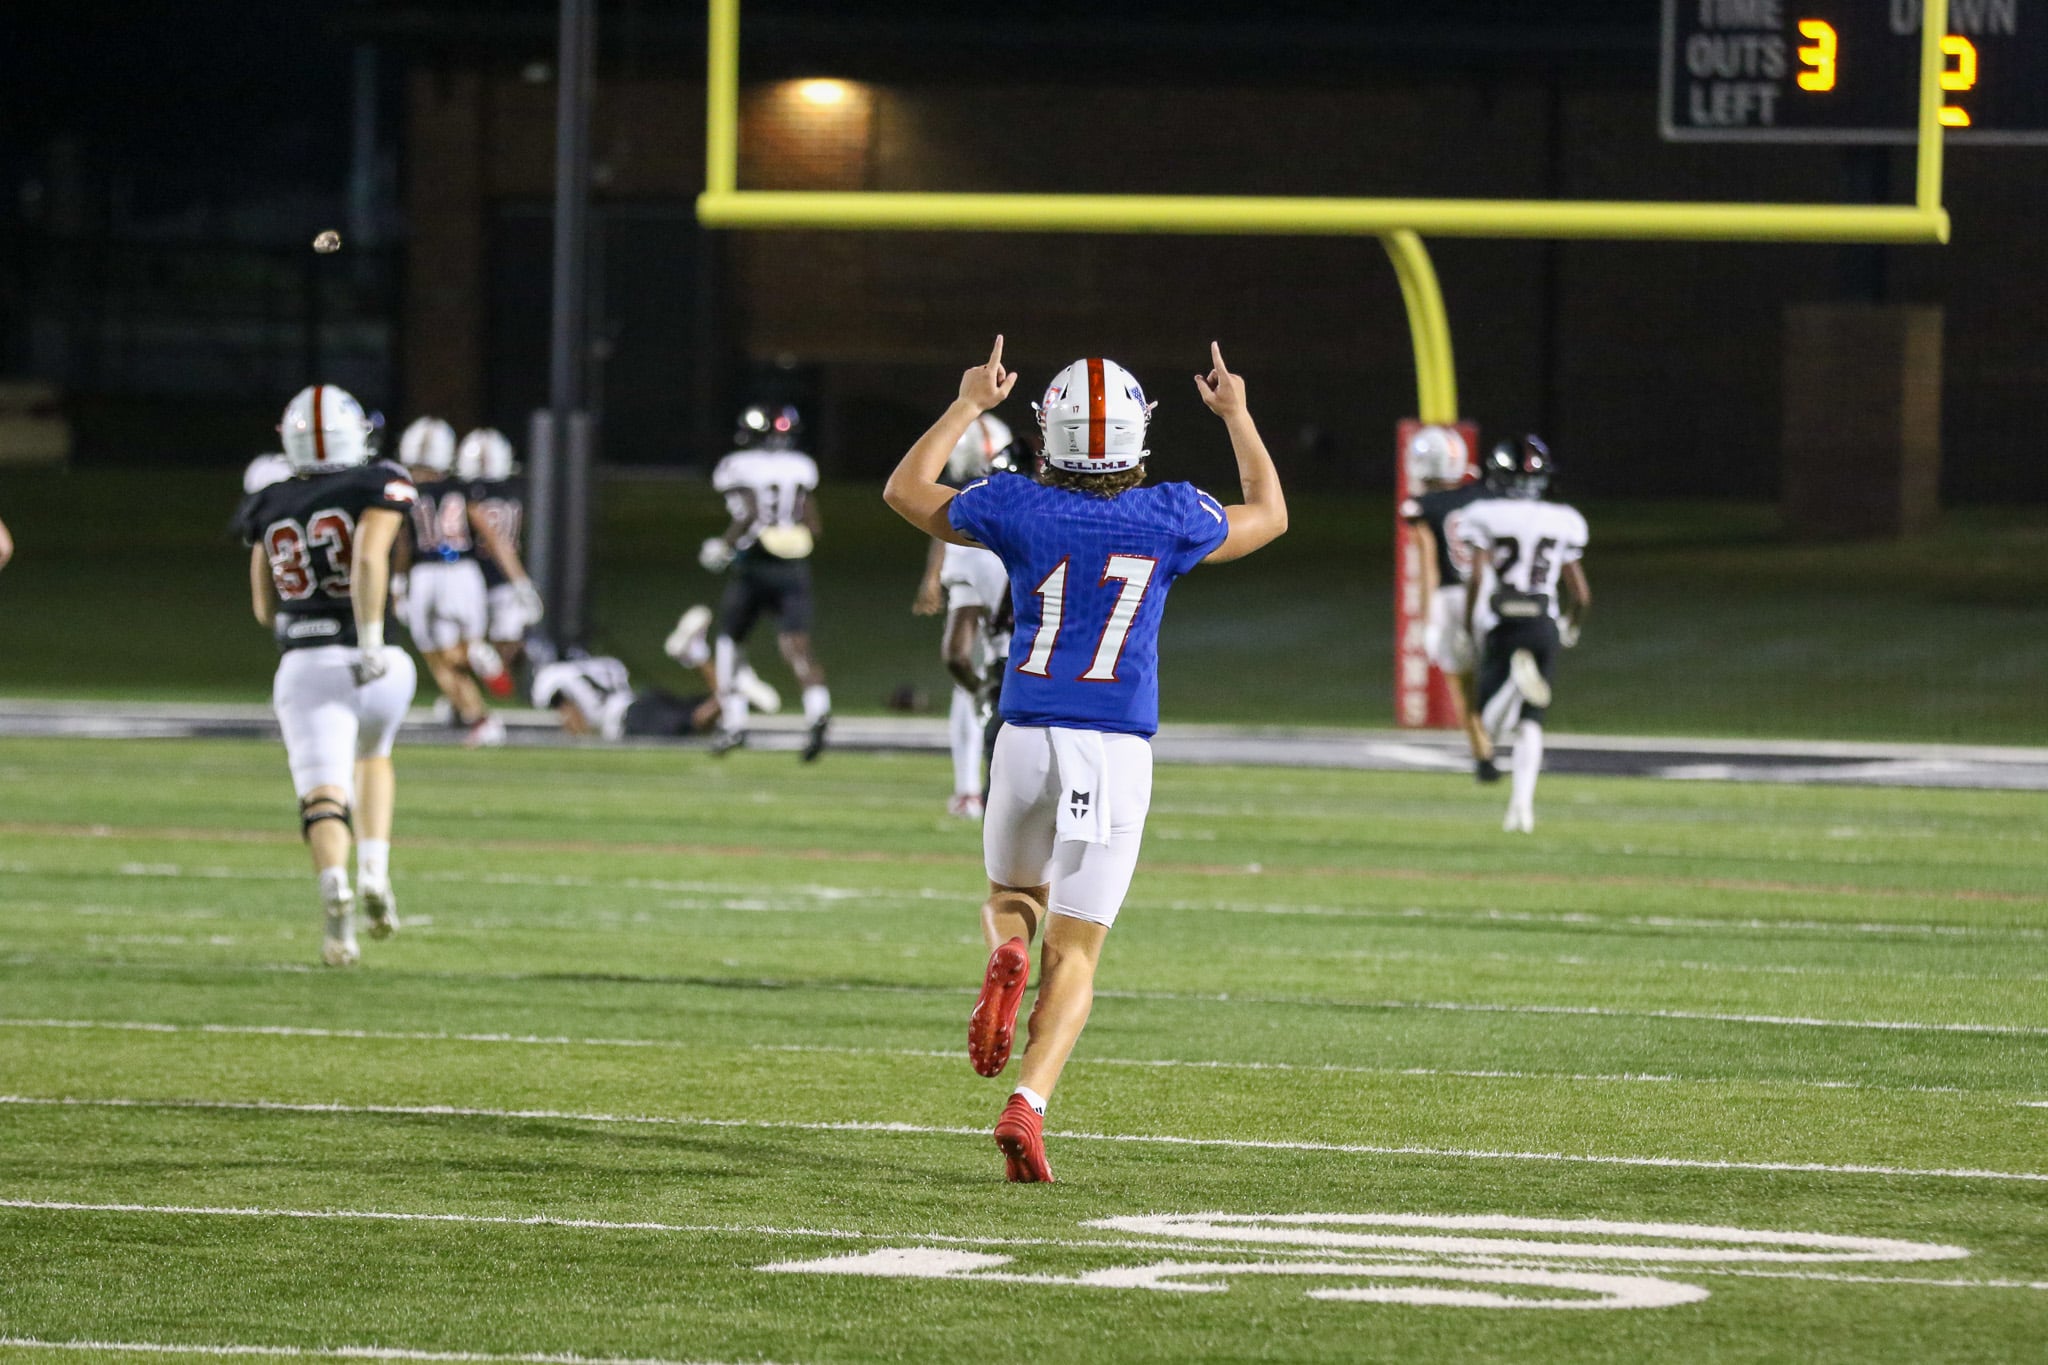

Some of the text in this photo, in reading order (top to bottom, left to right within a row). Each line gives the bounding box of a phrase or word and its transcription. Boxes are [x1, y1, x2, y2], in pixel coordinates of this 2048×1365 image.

[1686, 33, 1787, 78] OUTS
[1797, 19, 1838, 91] 3
[1690, 82, 1781, 126] LEFT
[1014, 552, 1161, 683] 17
